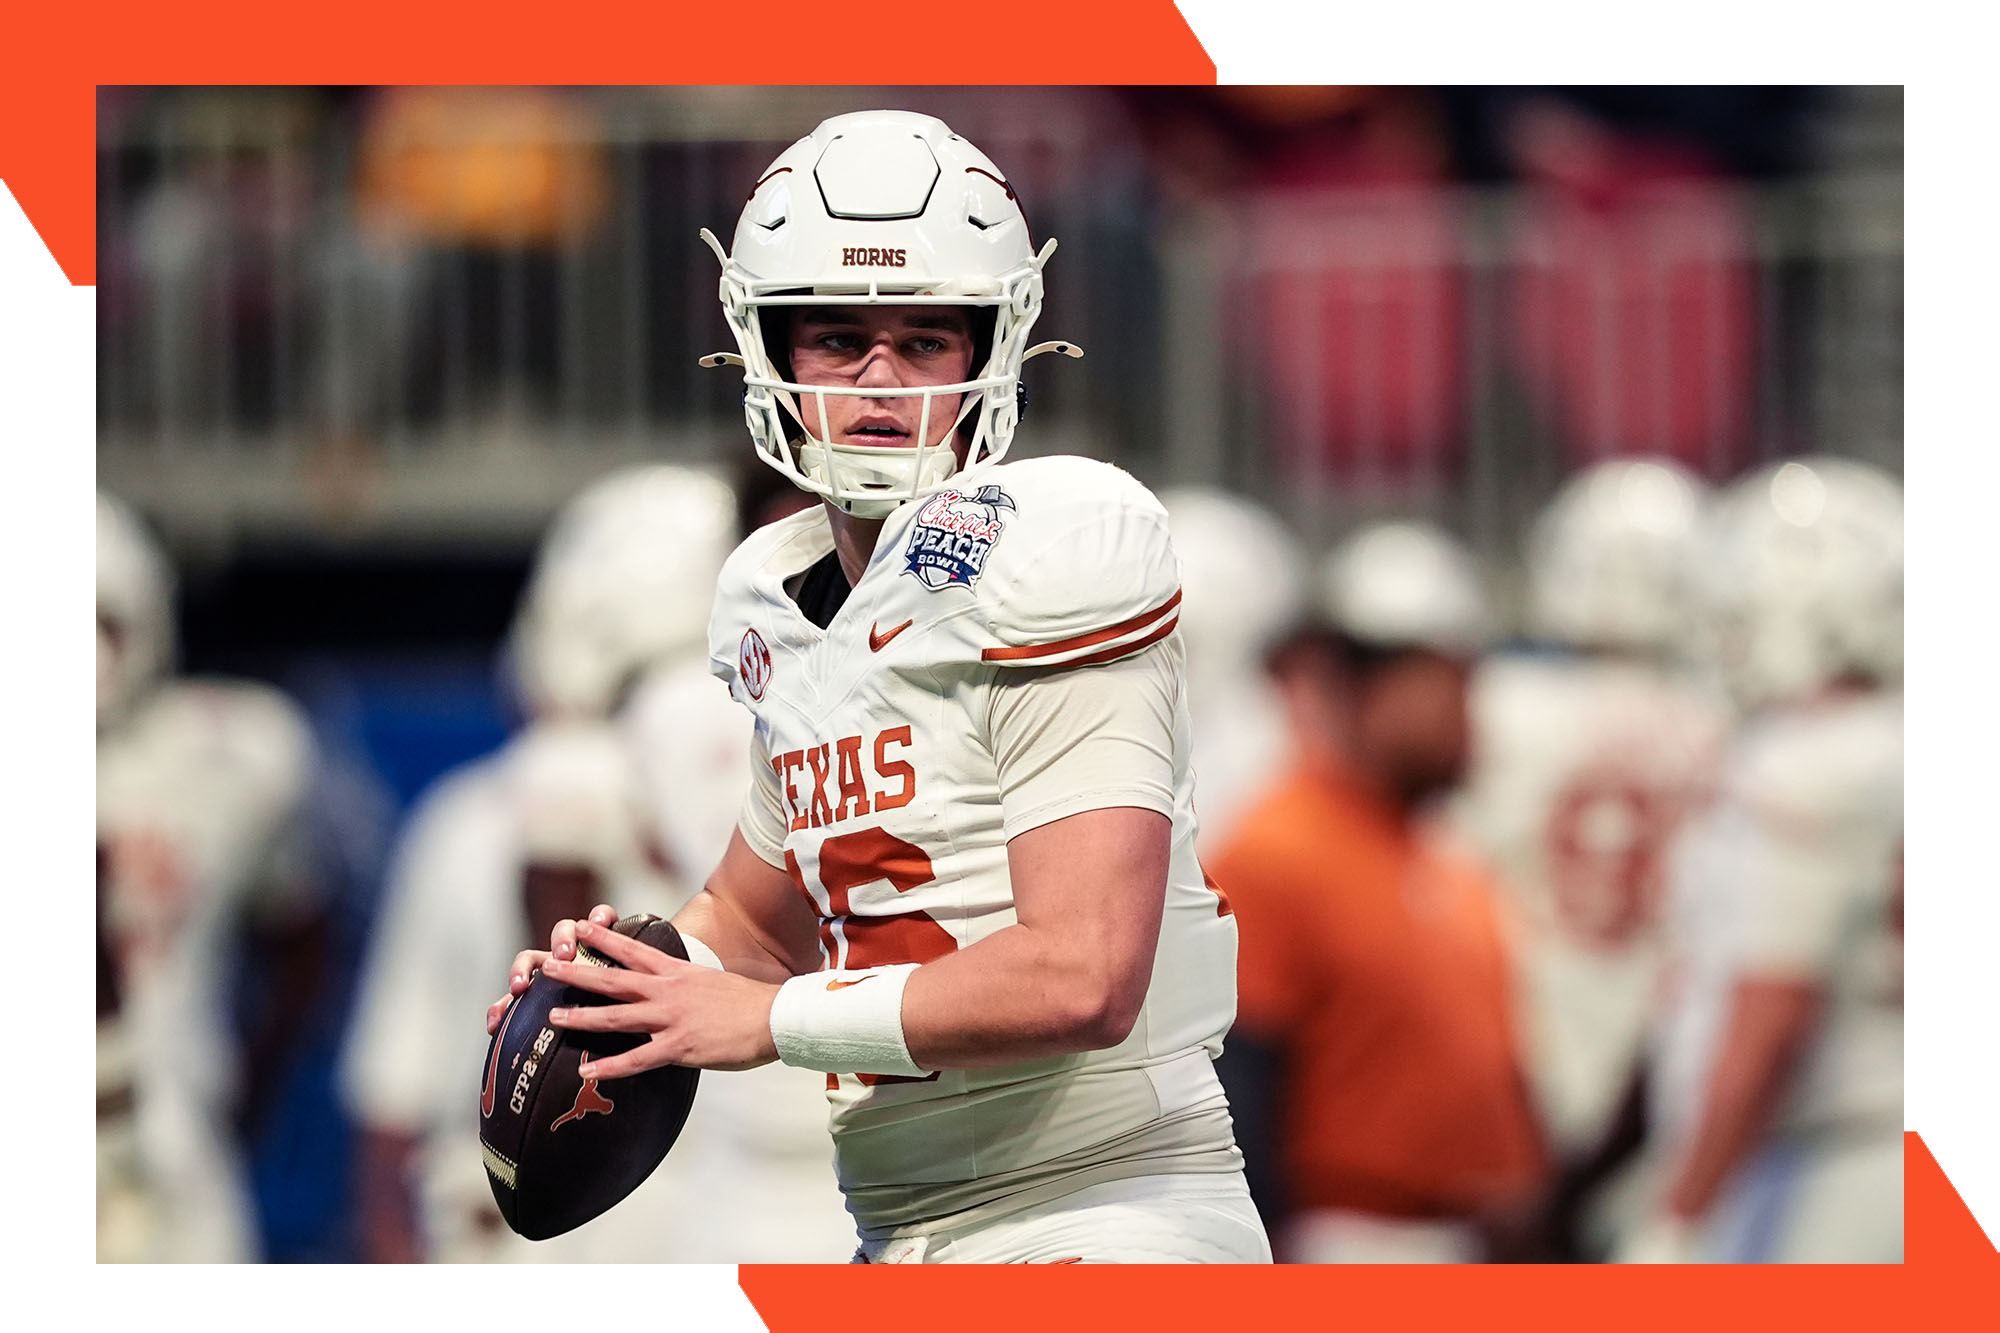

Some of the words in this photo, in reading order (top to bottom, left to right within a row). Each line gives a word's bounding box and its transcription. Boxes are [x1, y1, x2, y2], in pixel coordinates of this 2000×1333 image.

[842, 247, 906, 267] HORNS
[908, 527, 989, 572] PEACH
[917, 554, 961, 573] BOWL
